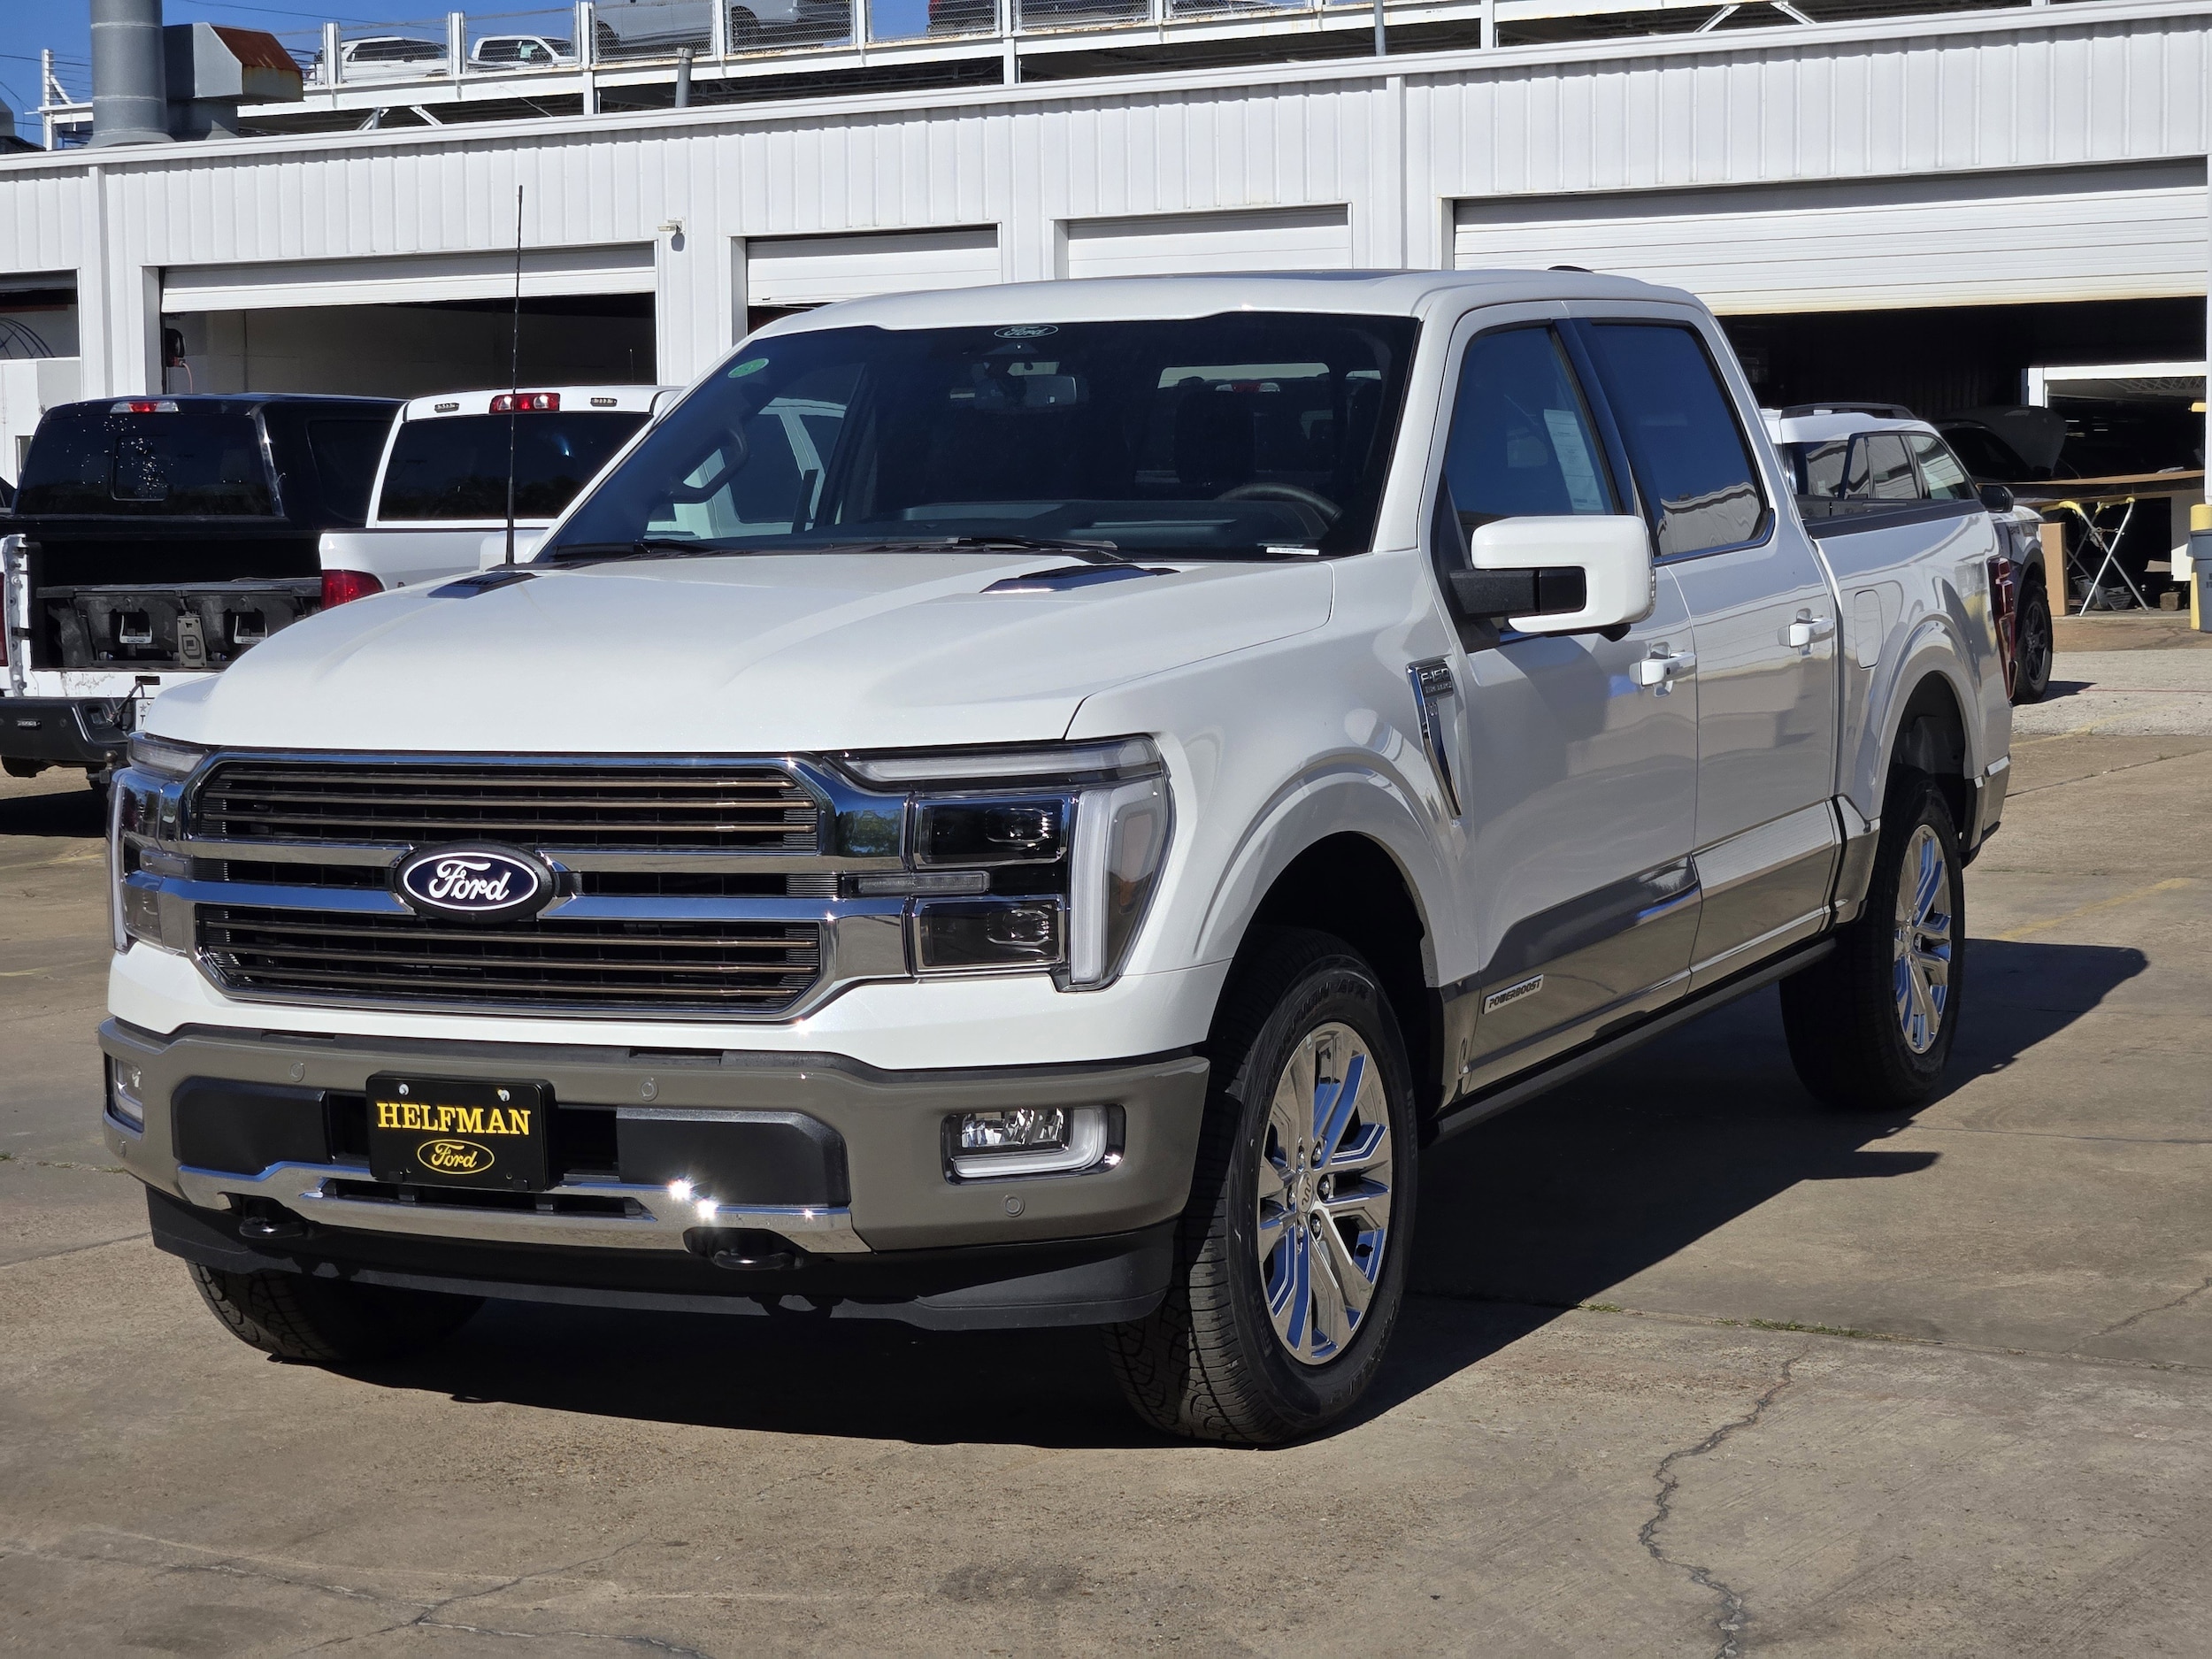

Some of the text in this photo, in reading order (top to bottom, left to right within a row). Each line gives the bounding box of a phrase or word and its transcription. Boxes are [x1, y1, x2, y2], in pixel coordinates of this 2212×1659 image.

[1003, 326, 1048, 336] Ford
[428, 859, 511, 901] Ford
[1489, 979, 1541, 1009] POWERBOOST
[376, 1102, 531, 1135] HELFMAN
[431, 1142, 478, 1168] Ford
